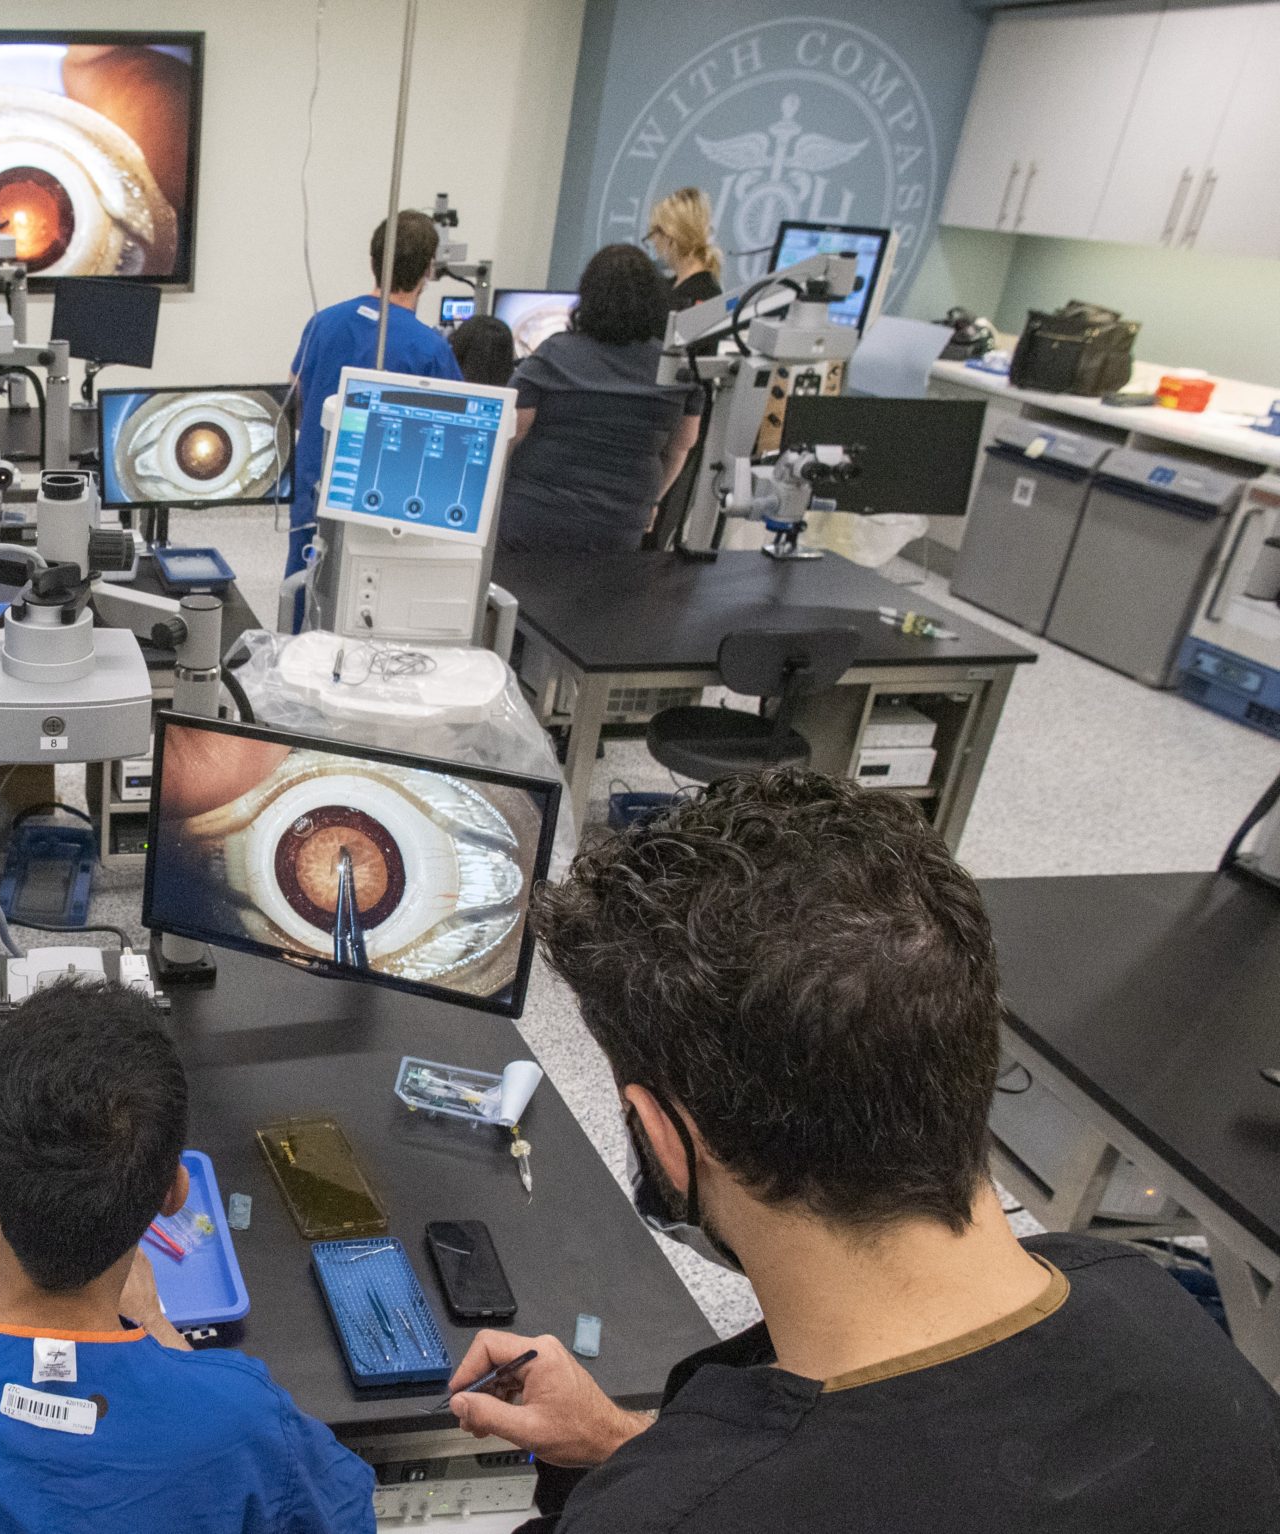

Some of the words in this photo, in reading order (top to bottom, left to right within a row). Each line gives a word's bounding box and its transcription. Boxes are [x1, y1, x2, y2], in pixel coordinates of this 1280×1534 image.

[628, 37, 762, 160] WITH
[795, 29, 925, 275] COMPASS
[50, 739, 57, 748] 8
